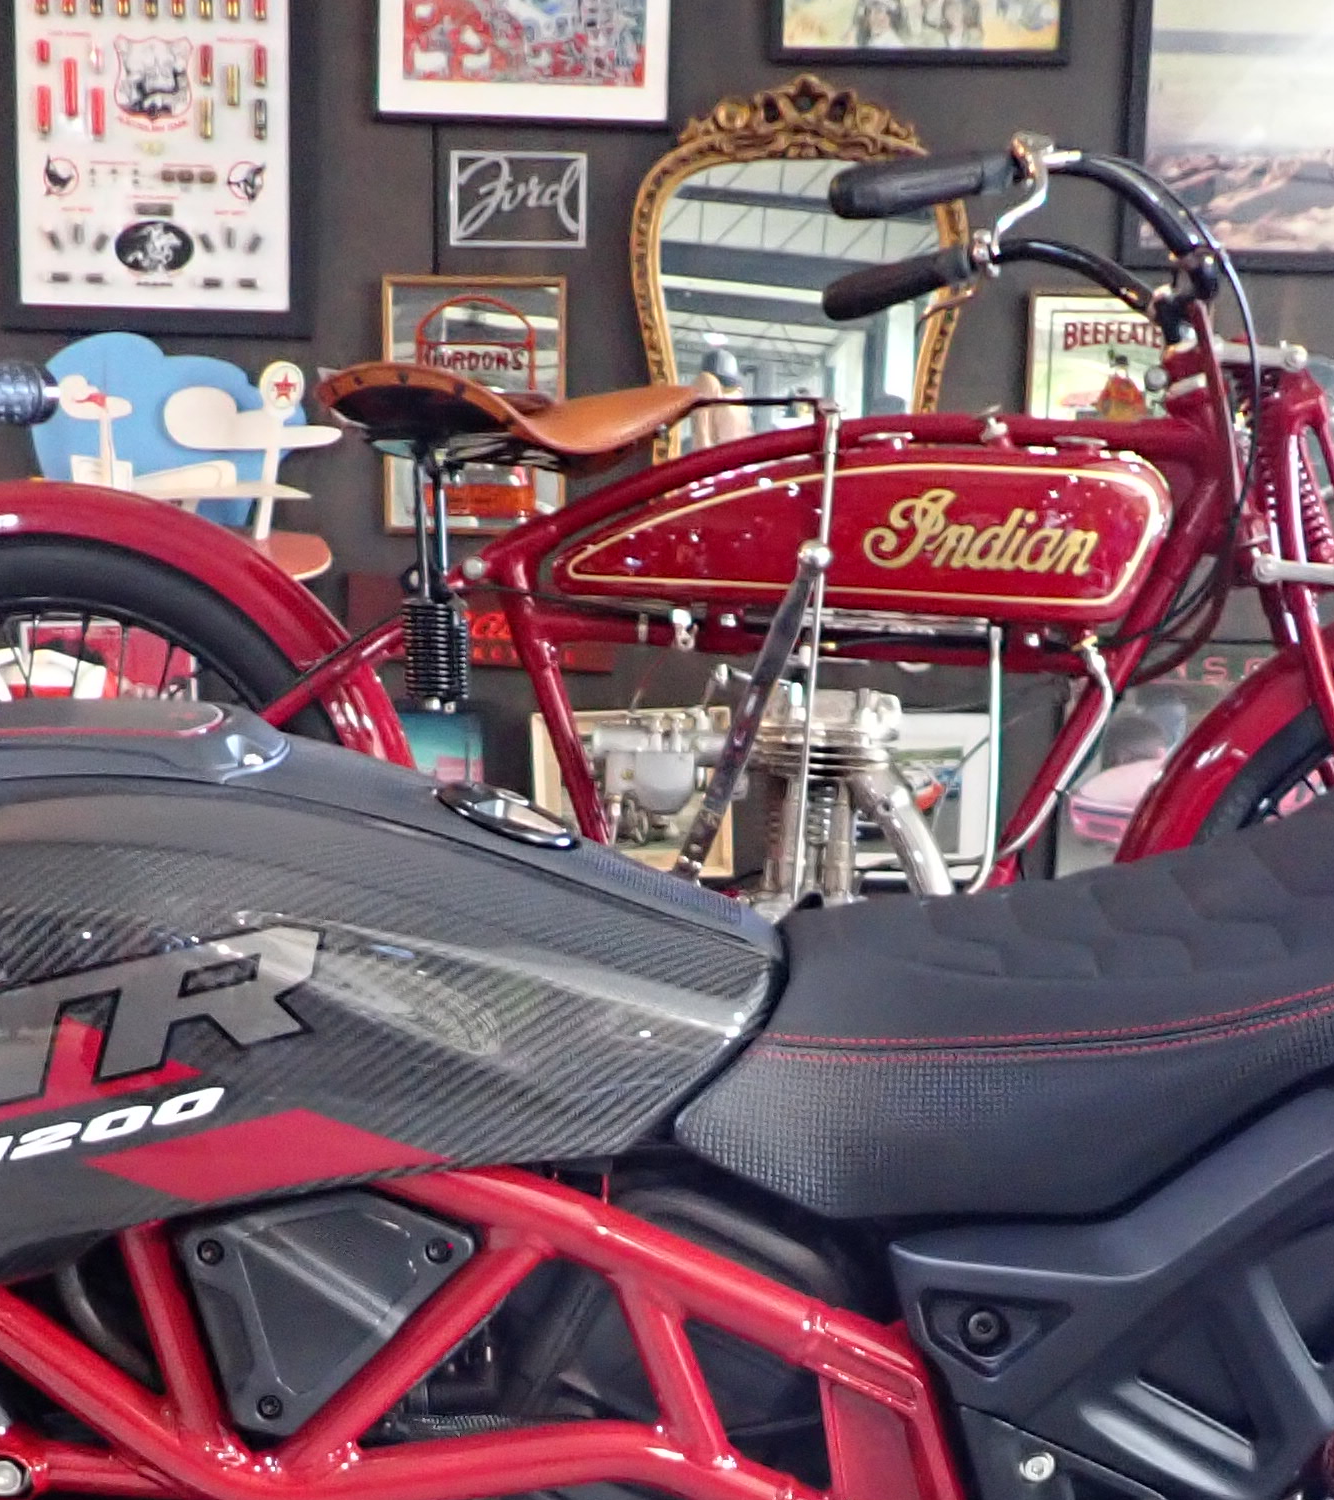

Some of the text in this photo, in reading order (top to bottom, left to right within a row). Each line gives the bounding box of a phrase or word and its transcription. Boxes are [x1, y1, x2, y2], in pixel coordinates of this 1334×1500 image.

[455, 153, 583, 241] Ford
[1063, 320, 1163, 352] BEEFEATE
[862, 487, 1099, 577] Indian
